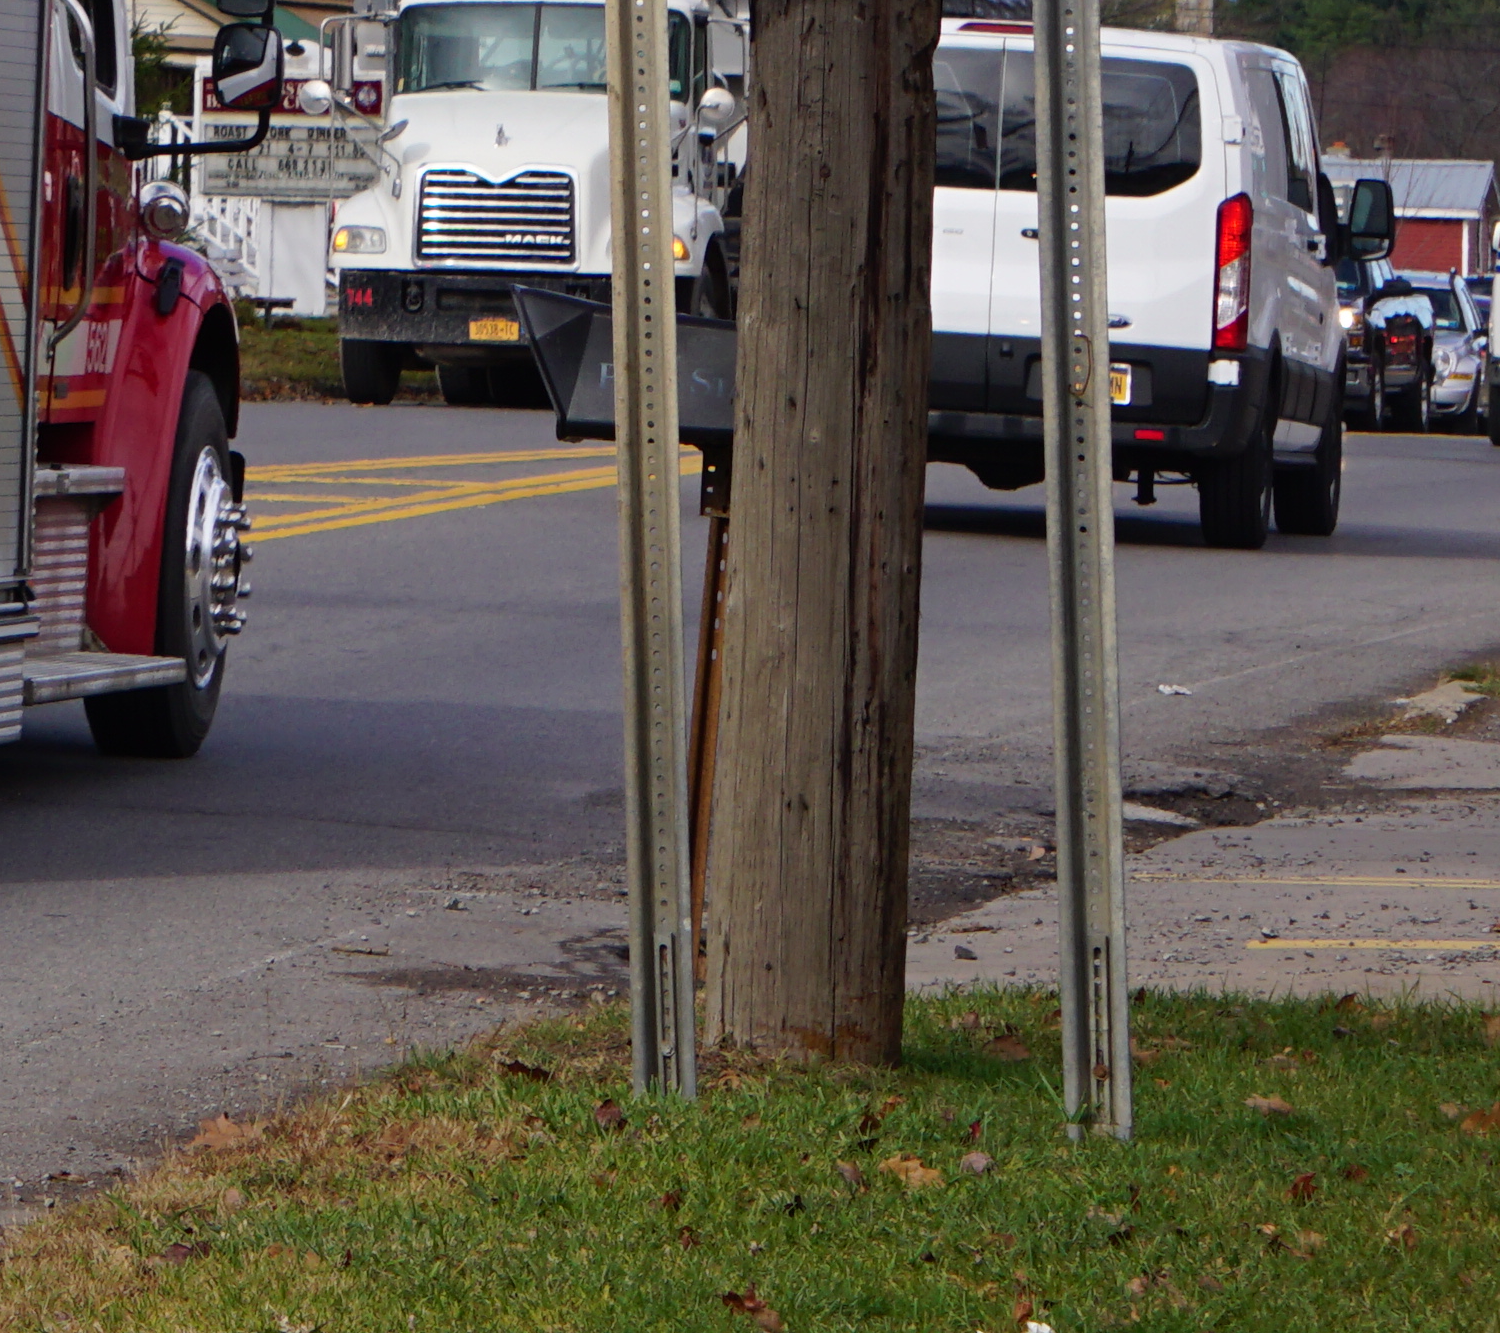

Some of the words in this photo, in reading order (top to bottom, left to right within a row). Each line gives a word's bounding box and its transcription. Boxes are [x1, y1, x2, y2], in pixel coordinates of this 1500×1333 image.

[214, 125, 248, 139] ROAST
[269, 126, 293, 140] ORK
[227, 158, 258, 171] CALL
[504, 234, 565, 246] MACK
[84, 321, 109, 374] 562
